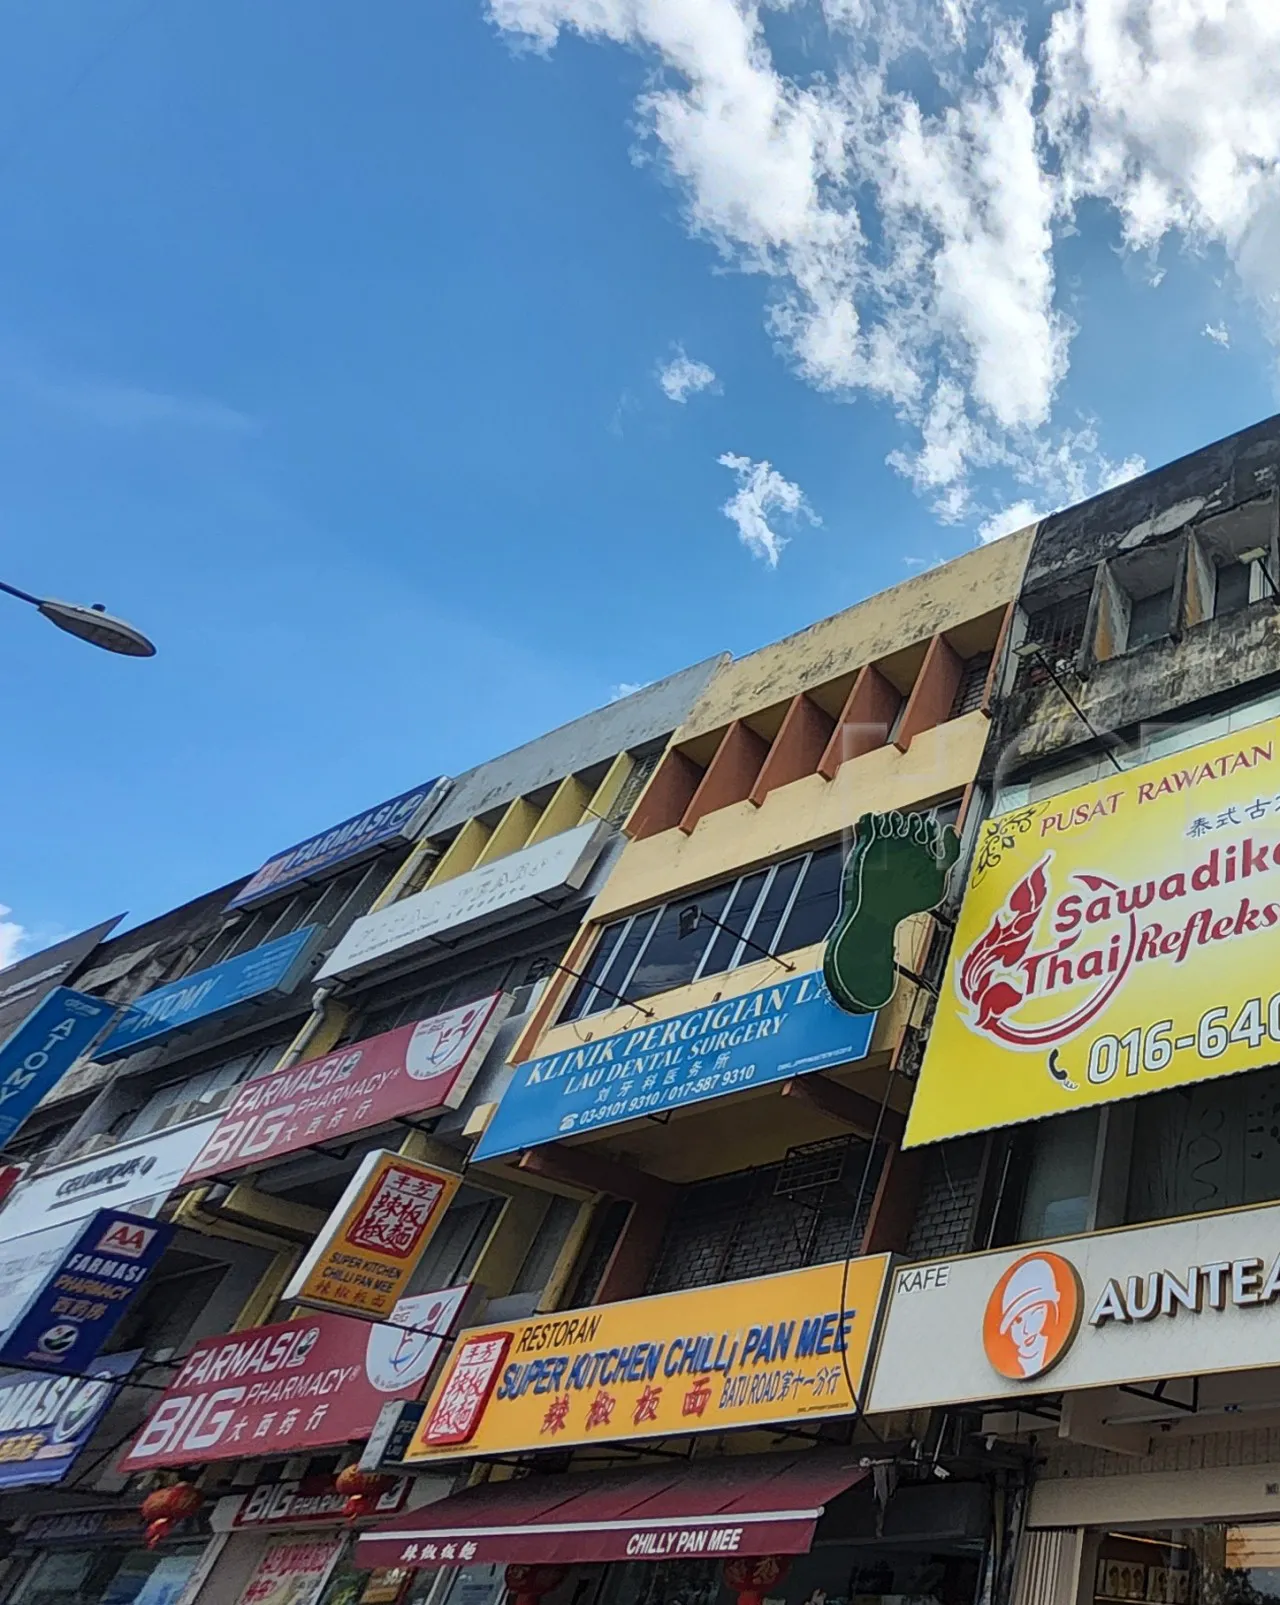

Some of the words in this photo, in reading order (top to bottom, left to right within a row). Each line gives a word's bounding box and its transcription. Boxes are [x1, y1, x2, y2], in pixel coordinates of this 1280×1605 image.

[1040, 791, 1126, 838] PUSAT
[1138, 741, 1274, 804] RAWATAN
[1018, 933, 1121, 998] Thai
[130, 975, 223, 1034] ATOMY
[525, 1035, 624, 1088] KLINIK
[623, 985, 786, 1057] PERGIGIAN
[564, 1069, 602, 1096] LAU
[604, 1049, 684, 1084] DENTAL
[689, 1013, 789, 1058] SURGERY
[226, 1056, 344, 1120] FARMASI
[579, 1099, 628, 1126] 03-9101
[628, 1094, 660, 1114] 9310
[668, 1072, 720, 1104] 017-587
[722, 1064, 757, 1088] 9310
[188, 1103, 296, 1174] BIG
[292, 1071, 392, 1118] PHARMACY
[105, 1225, 146, 1250] AA
[329, 1251, 362, 1269] SUPER
[362, 1258, 404, 1280] KITCHEN
[66, 1253, 148, 1283] FARMASI
[322, 1266, 356, 1282] CHILLI
[374, 1279, 397, 1294] MEE
[898, 1266, 949, 1293] KAFE
[173, 1330, 302, 1389] FARMASI
[496, 1357, 570, 1401] SUPER
[570, 1341, 665, 1394] KITCHEN
[739, 1320, 797, 1368] PAN
[794, 1309, 857, 1359] MEE
[516, 1315, 602, 1354] RESTORAN
[128, 1387, 246, 1460] BIG
[242, 1367, 352, 1407] PHARMACY
[540, 1377, 712, 1437] 辣椒板面
[719, 1376, 749, 1408] BATU
[750, 1370, 781, 1405] ROAD
[241, 1481, 300, 1522] BIG
[626, 1530, 678, 1555] CHILLY
[677, 1530, 710, 1552] PAN
[708, 1528, 744, 1552] MEE
